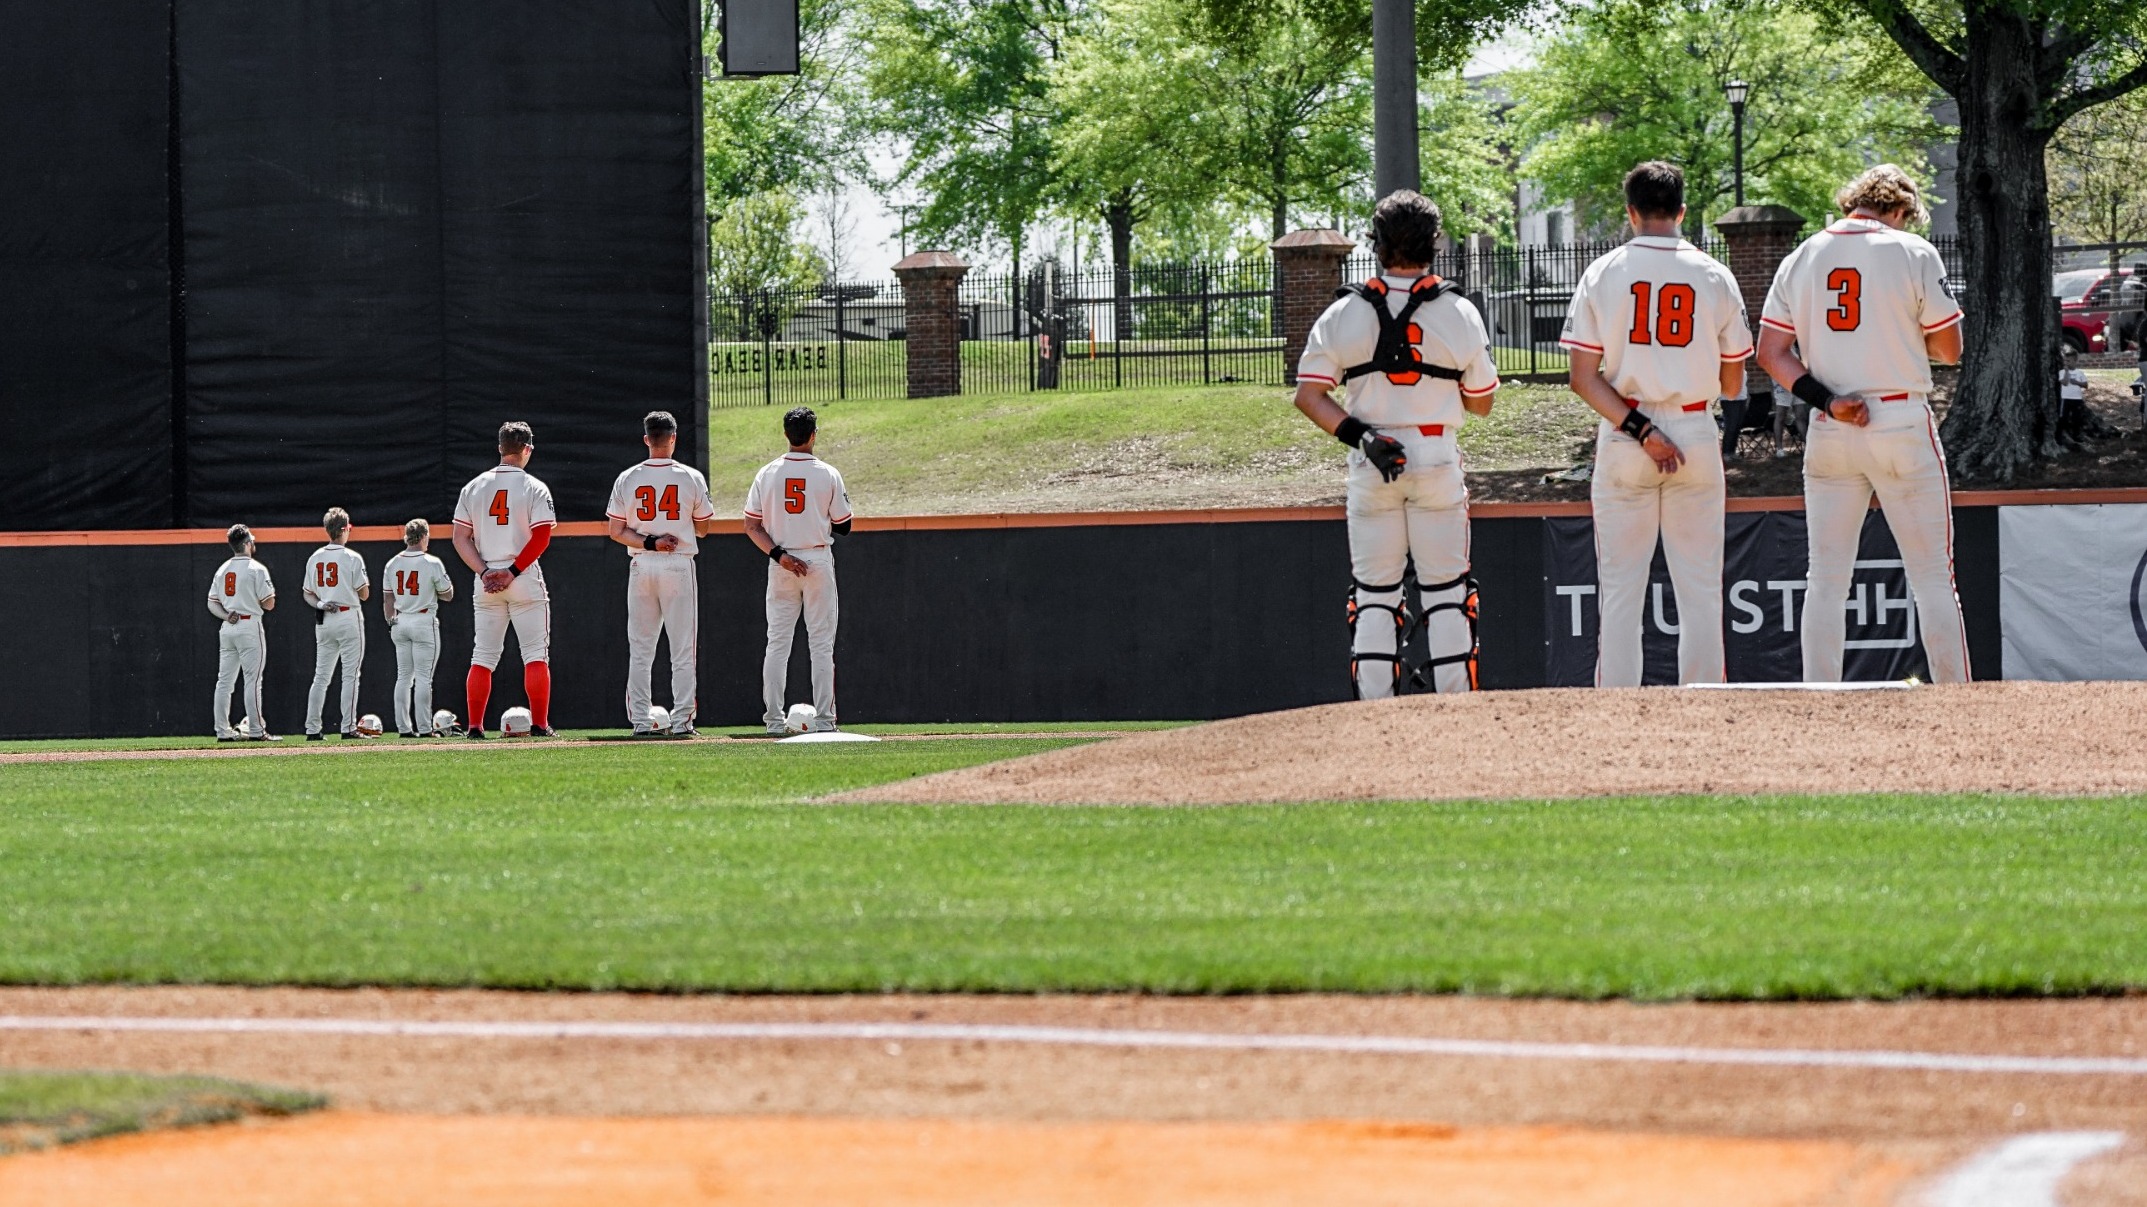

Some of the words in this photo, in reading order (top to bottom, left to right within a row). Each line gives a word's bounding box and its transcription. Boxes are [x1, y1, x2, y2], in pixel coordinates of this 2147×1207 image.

[1628, 281, 1696, 348] 18
[1826, 267, 1862, 332] 3
[488, 489, 510, 526] 4
[634, 484, 681, 522] 34
[784, 477, 807, 515] 5
[224, 571, 237, 597] 8
[316, 562, 339, 587] 13
[396, 570, 420, 596] 14
